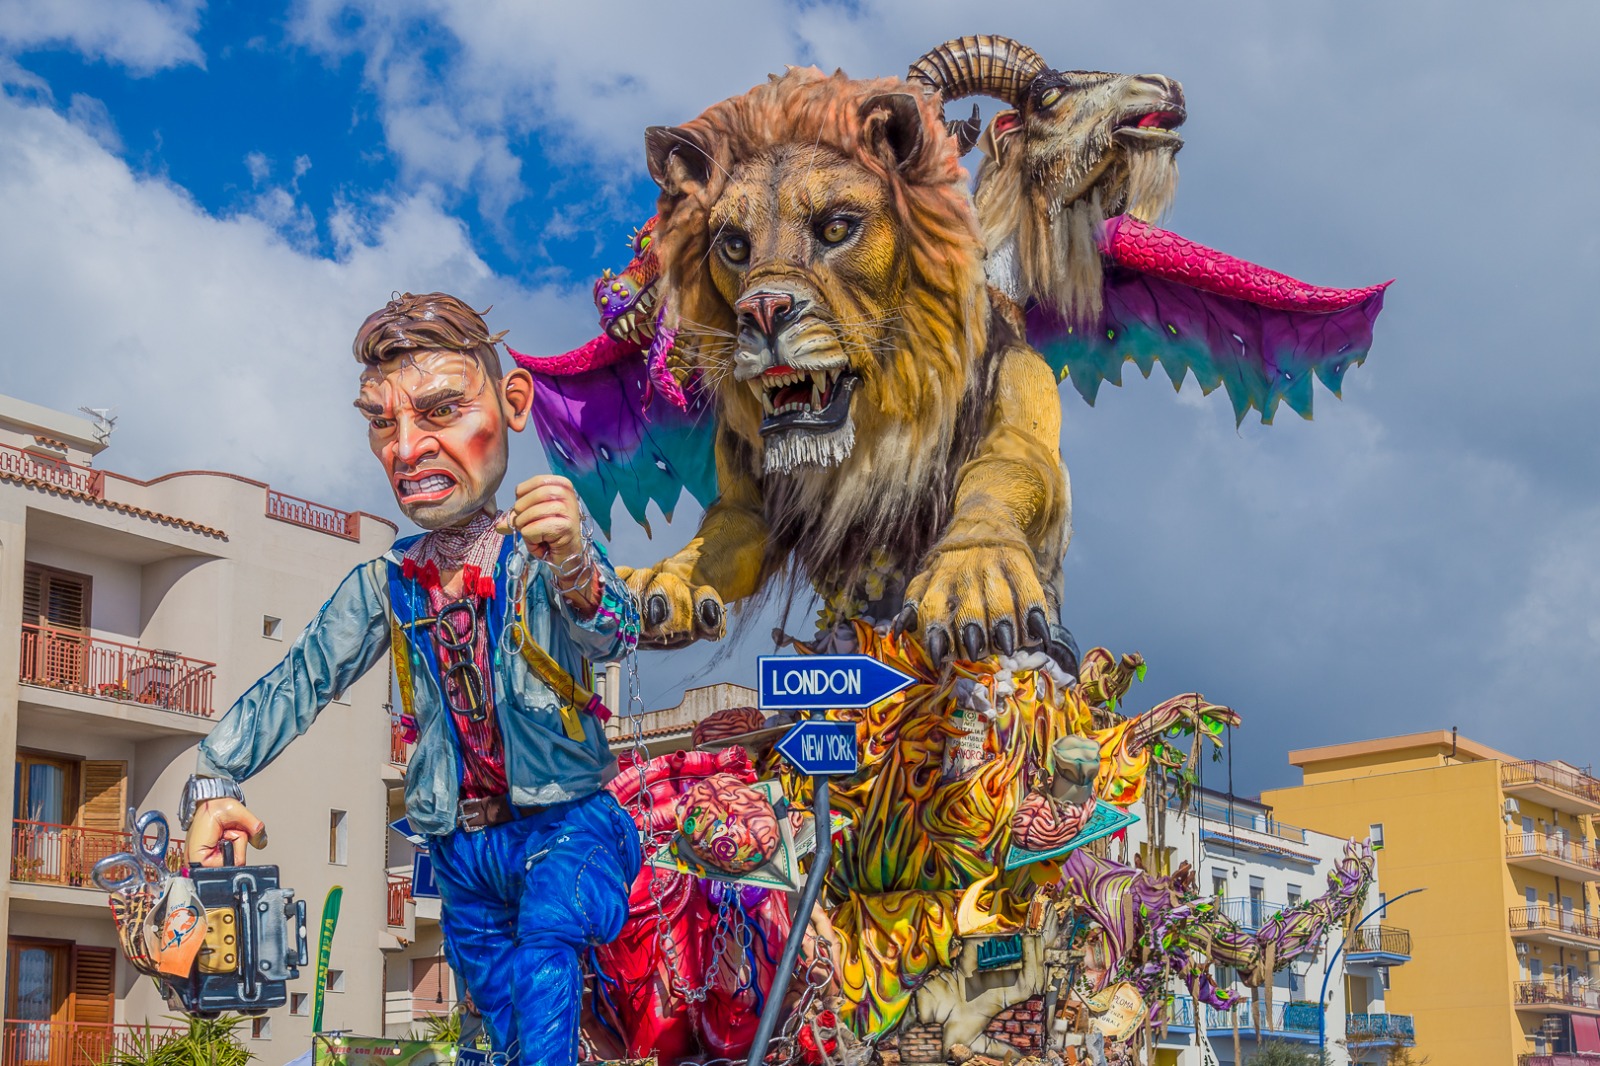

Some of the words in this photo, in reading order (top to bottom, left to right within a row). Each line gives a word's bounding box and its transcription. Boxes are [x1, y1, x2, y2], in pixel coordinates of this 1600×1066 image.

[772, 669, 861, 695] LONDON
[801, 734, 824, 761] NEW
[826, 734, 856, 761] YORK
